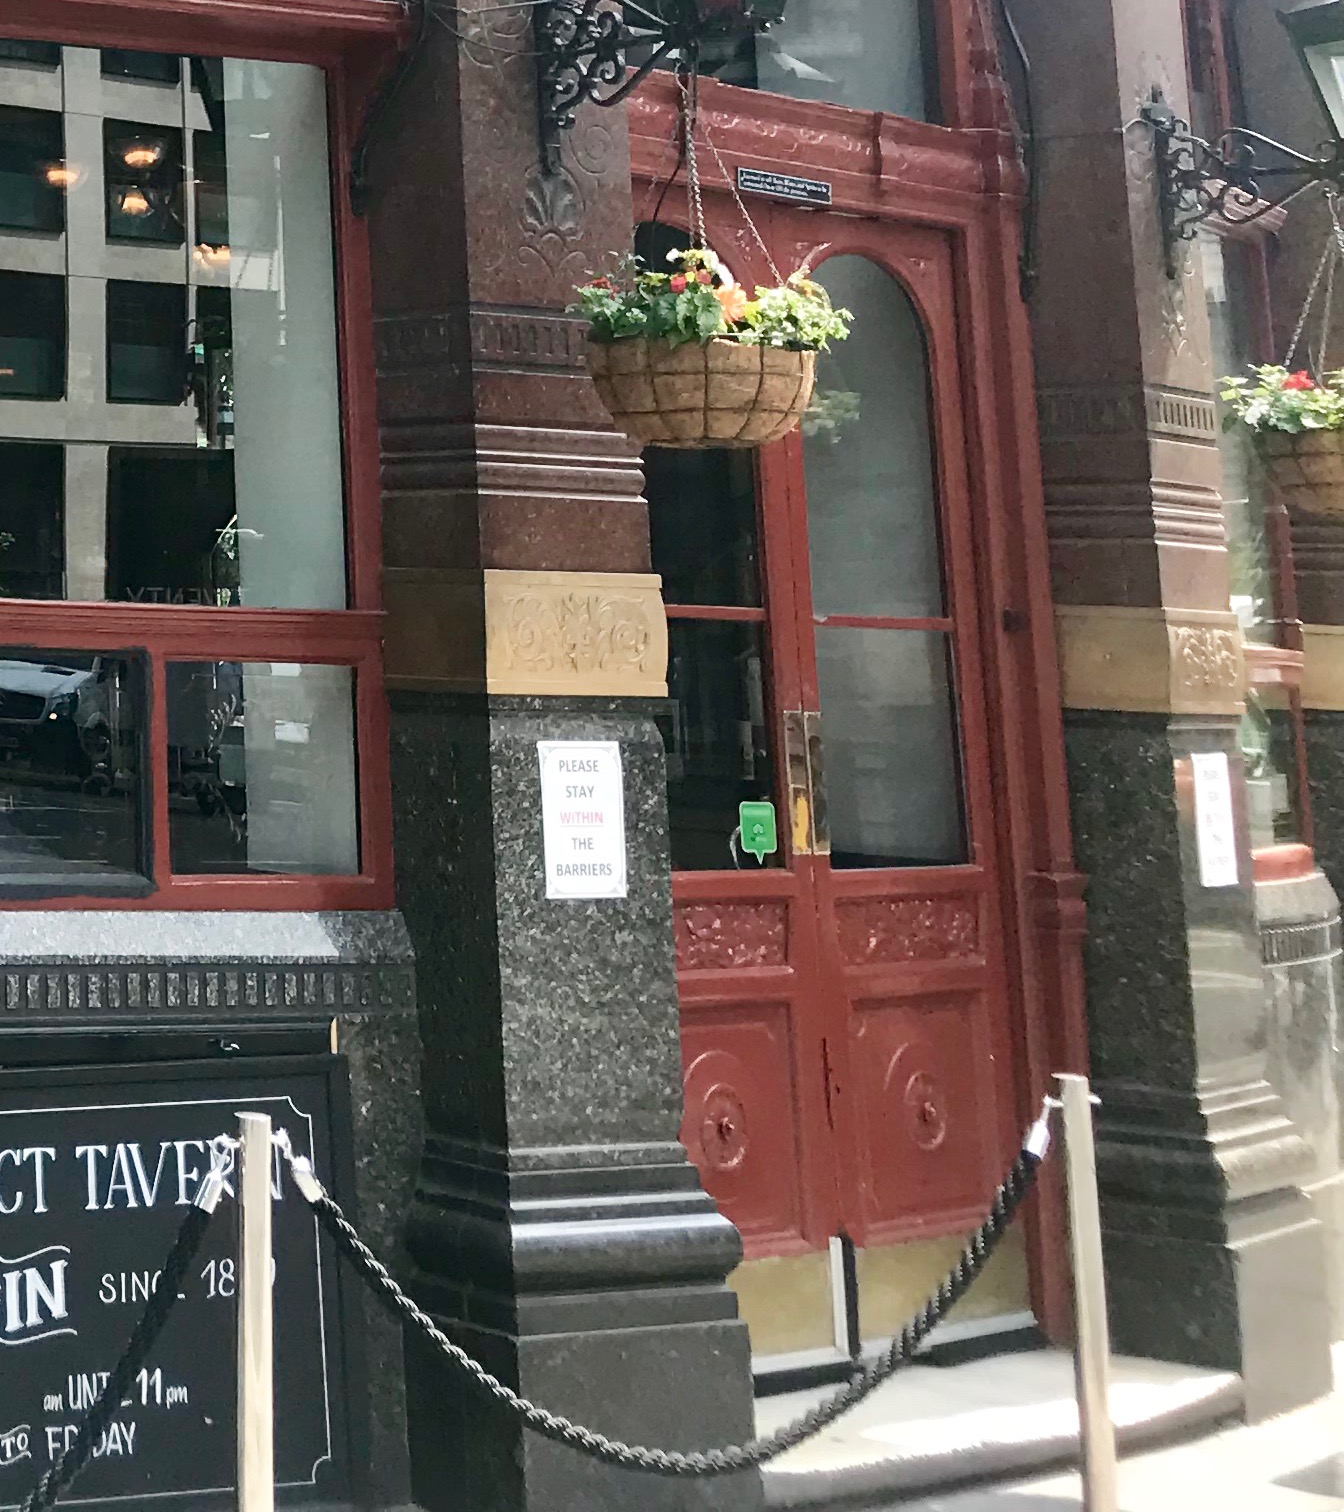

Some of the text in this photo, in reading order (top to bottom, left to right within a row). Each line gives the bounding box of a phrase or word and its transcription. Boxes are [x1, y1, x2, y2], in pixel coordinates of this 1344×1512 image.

[558, 759, 599, 773] PLEASE
[565, 785, 595, 798] STAY
[560, 811, 604, 824] WITHIN
[571, 837, 594, 850] THE
[556, 863, 612, 876] BARRIERS
[99, 1269, 186, 1303] SIN
[43, 1394, 63, 1411] am
[68, 1371, 133, 1410] UNT
[45, 1421, 136, 1460] FRDAY
